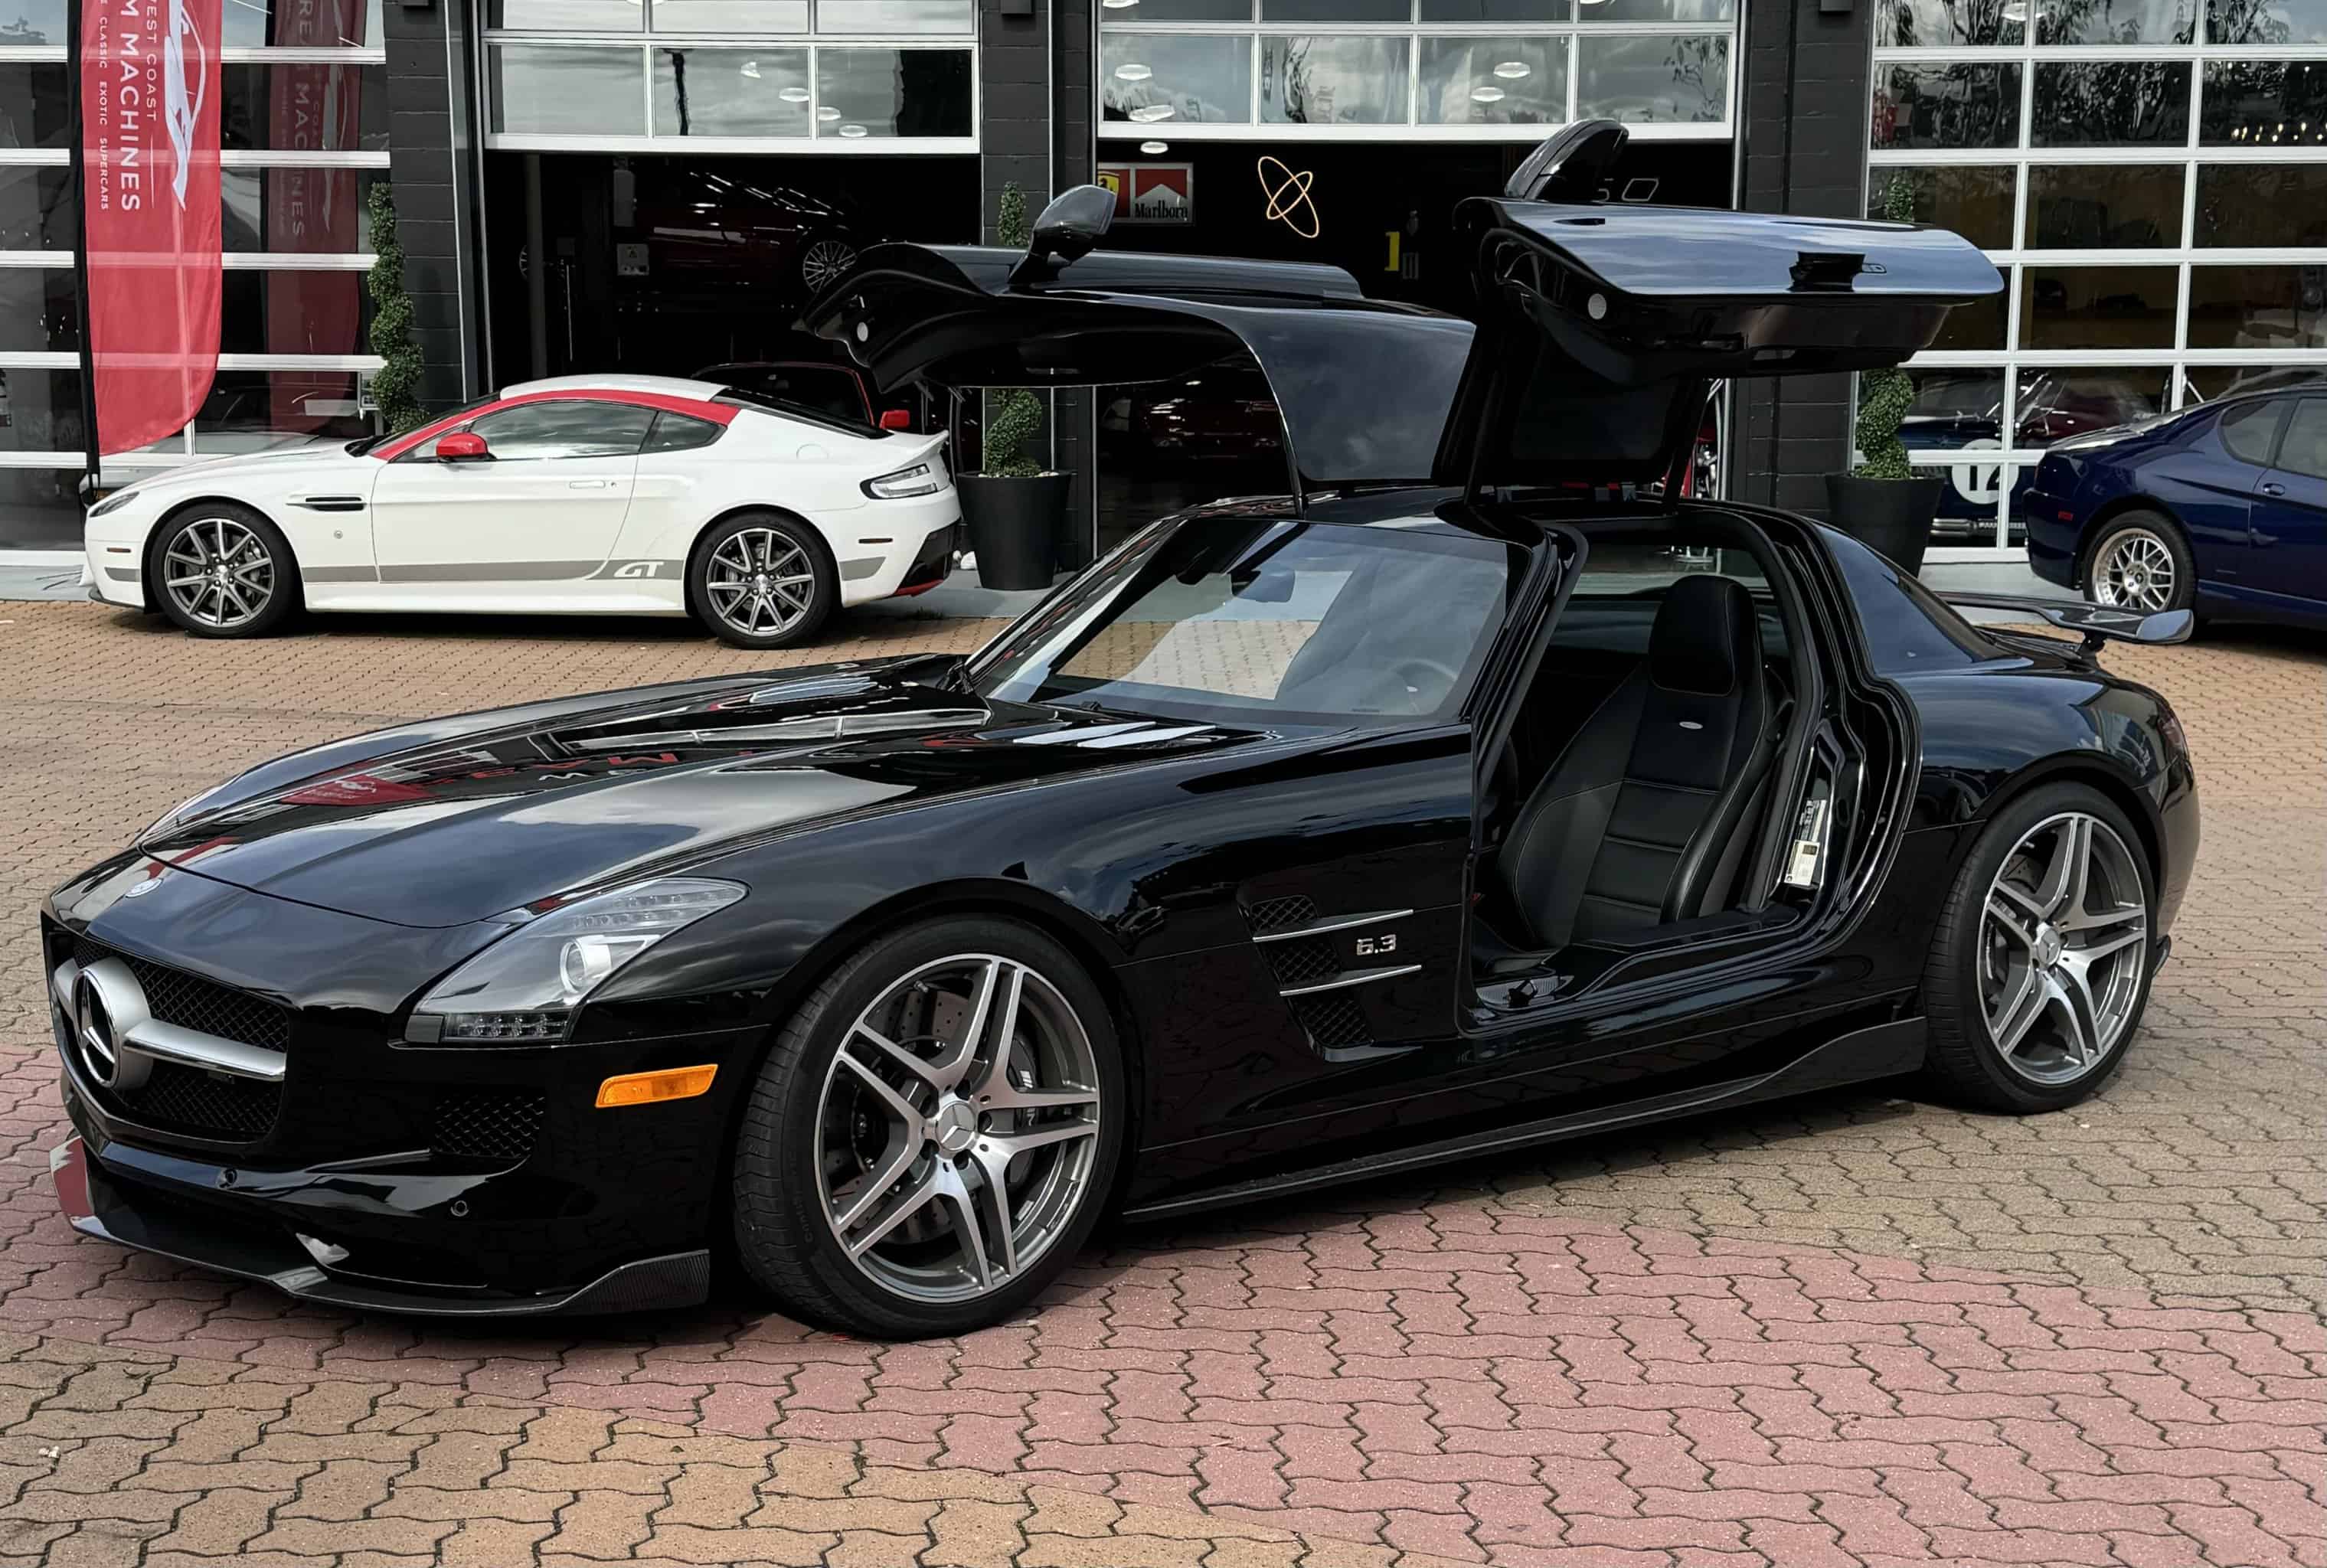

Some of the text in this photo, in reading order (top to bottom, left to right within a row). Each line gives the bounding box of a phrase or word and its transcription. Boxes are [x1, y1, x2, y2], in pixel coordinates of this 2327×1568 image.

[99, 16, 108, 69] CLASSIC
[146, 0, 157, 122] EST COAST
[99, 81, 108, 126] EXOTIC
[120, 33, 140, 211] MACHINES
[99, 137, 109, 211] SUPERCARS
[1134, 200, 1188, 219] Marlboro
[613, 560, 664, 577] GT
[1356, 933, 1397, 956] 6.3
